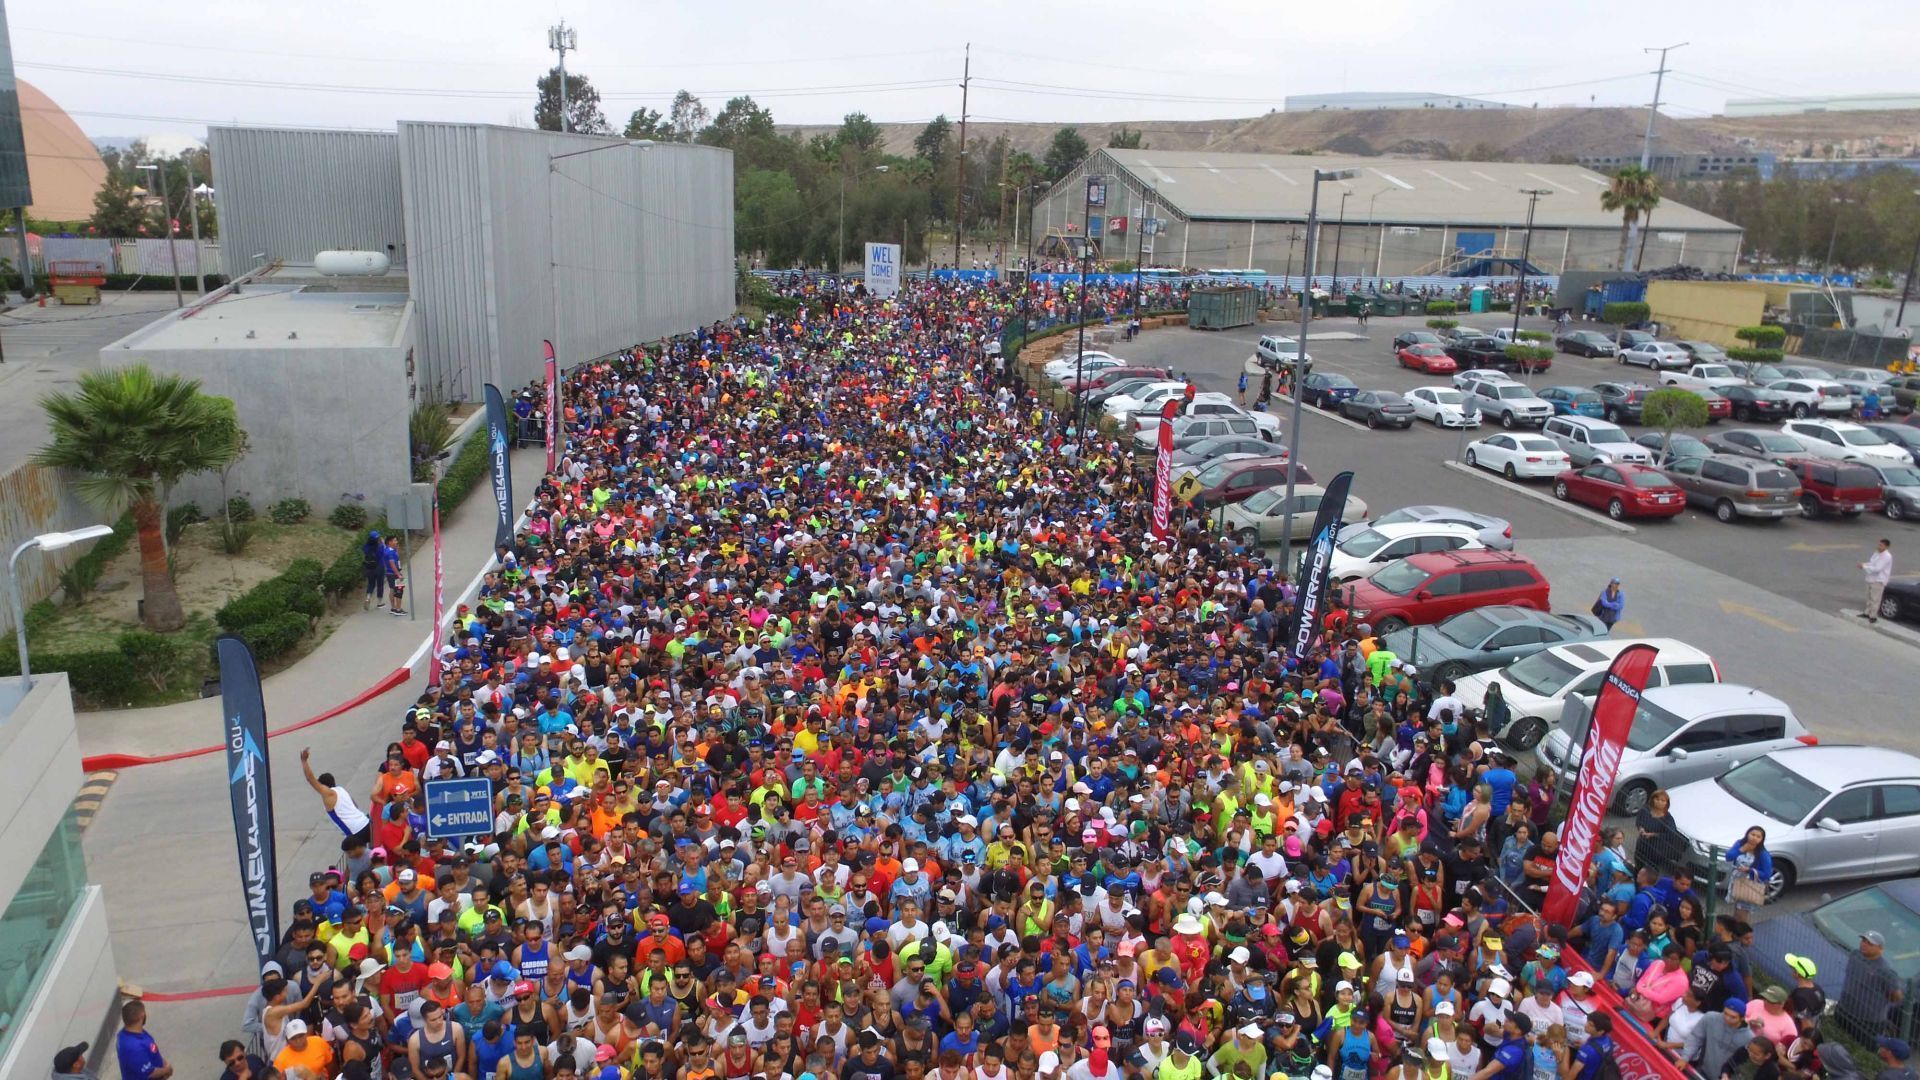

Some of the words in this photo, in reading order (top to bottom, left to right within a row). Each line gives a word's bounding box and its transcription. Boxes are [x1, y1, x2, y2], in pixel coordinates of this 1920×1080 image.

[872, 246, 893, 263] WEL
[1296, 538, 1327, 658] POWERADE
[1617, 680, 1641, 701] AZÚCA
[447, 811, 489, 825] ENTRADA
